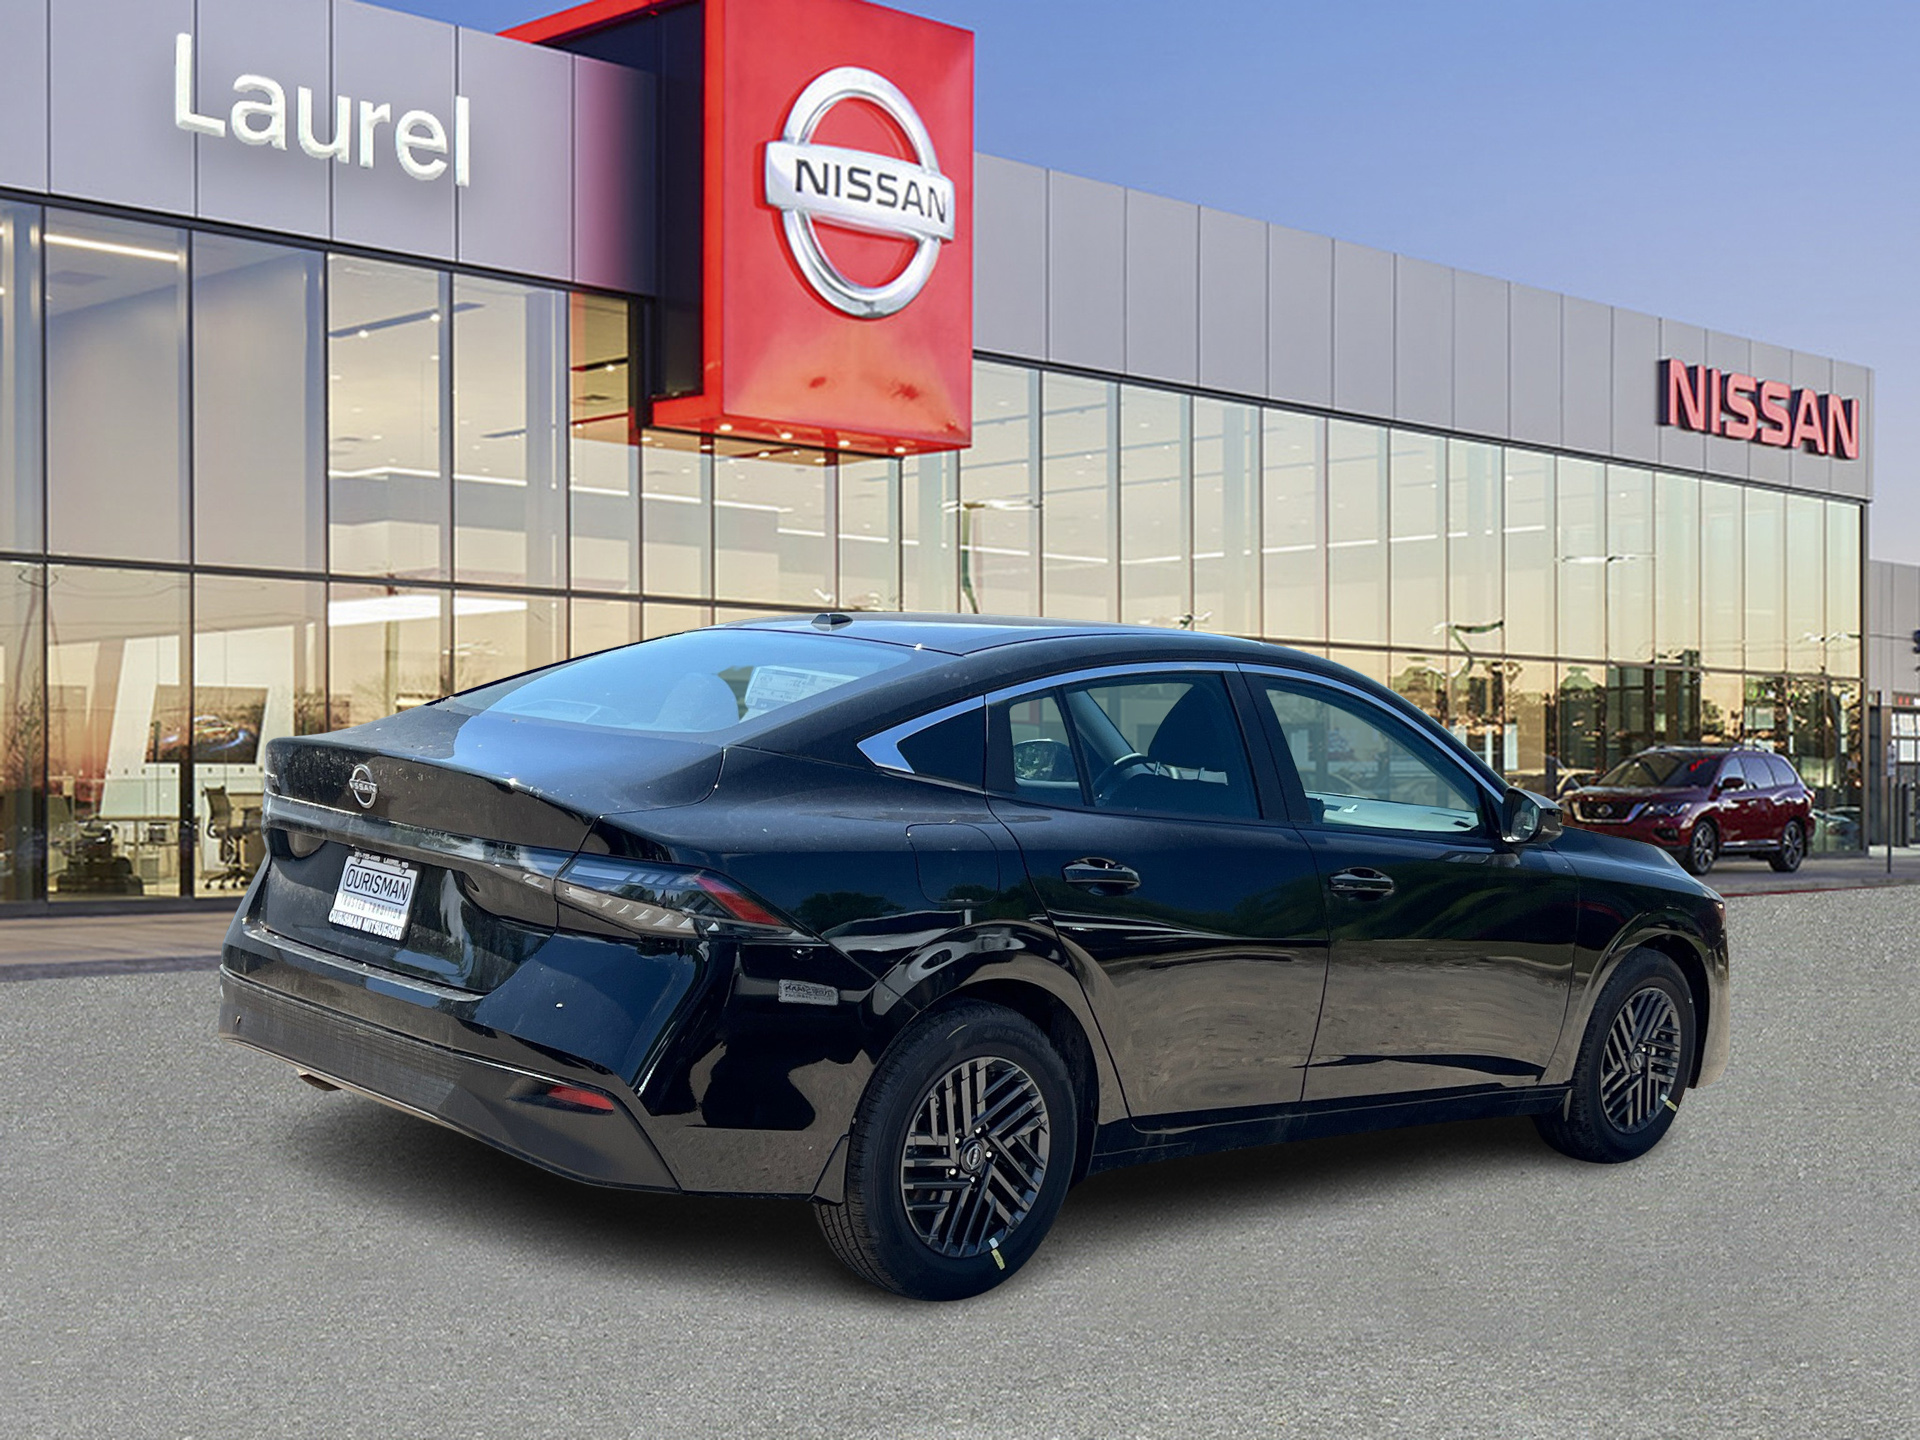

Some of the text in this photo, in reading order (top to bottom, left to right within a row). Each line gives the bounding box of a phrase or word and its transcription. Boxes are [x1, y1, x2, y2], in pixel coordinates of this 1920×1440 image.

[175, 32, 470, 188] Laurel
[794, 158, 947, 224] NISSAN
[1657, 358, 1860, 460] NISSAN
[350, 781, 377, 794] SSAN
[345, 868, 410, 901] OURISMAN
[341, 894, 366, 911] TRUSTED
[328, 909, 362, 930] OURISMAN
